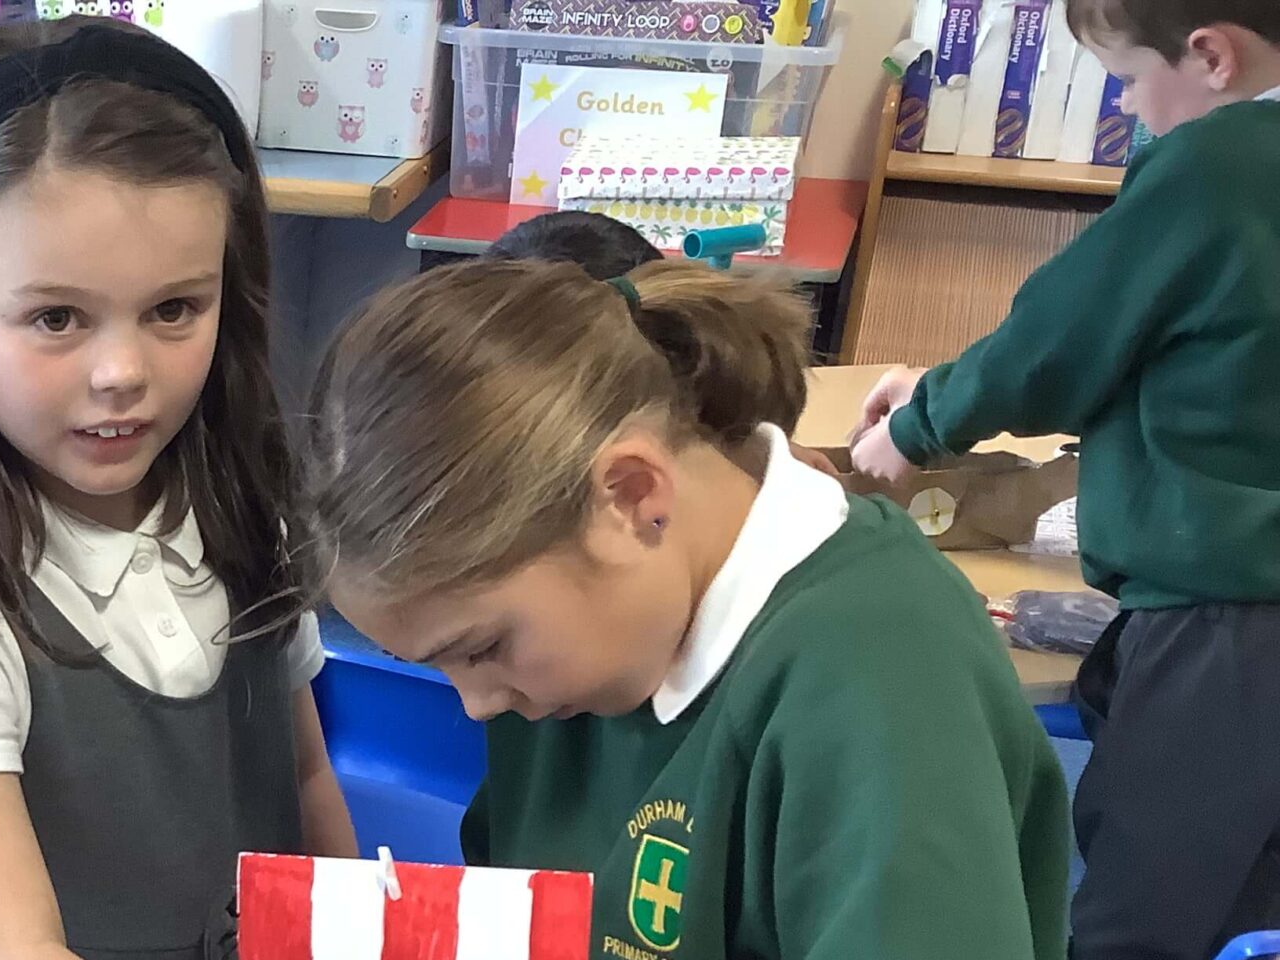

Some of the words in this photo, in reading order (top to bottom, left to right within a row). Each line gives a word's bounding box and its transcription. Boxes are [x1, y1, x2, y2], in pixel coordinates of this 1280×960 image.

[521, 15, 553, 24] MAZE
[523, 8, 553, 16] BRAIN
[562, 11, 623, 27] INFINITY
[628, 14, 670, 29] LOOP
[957, 9, 972, 44] Oxford
[1025, 11, 1040, 46] Oxford
[941, 8, 960, 60] Dictionary
[1008, 10, 1029, 63] Dictionary
[576, 91, 664, 115] Golden
[627, 799, 686, 839] DURHAM
